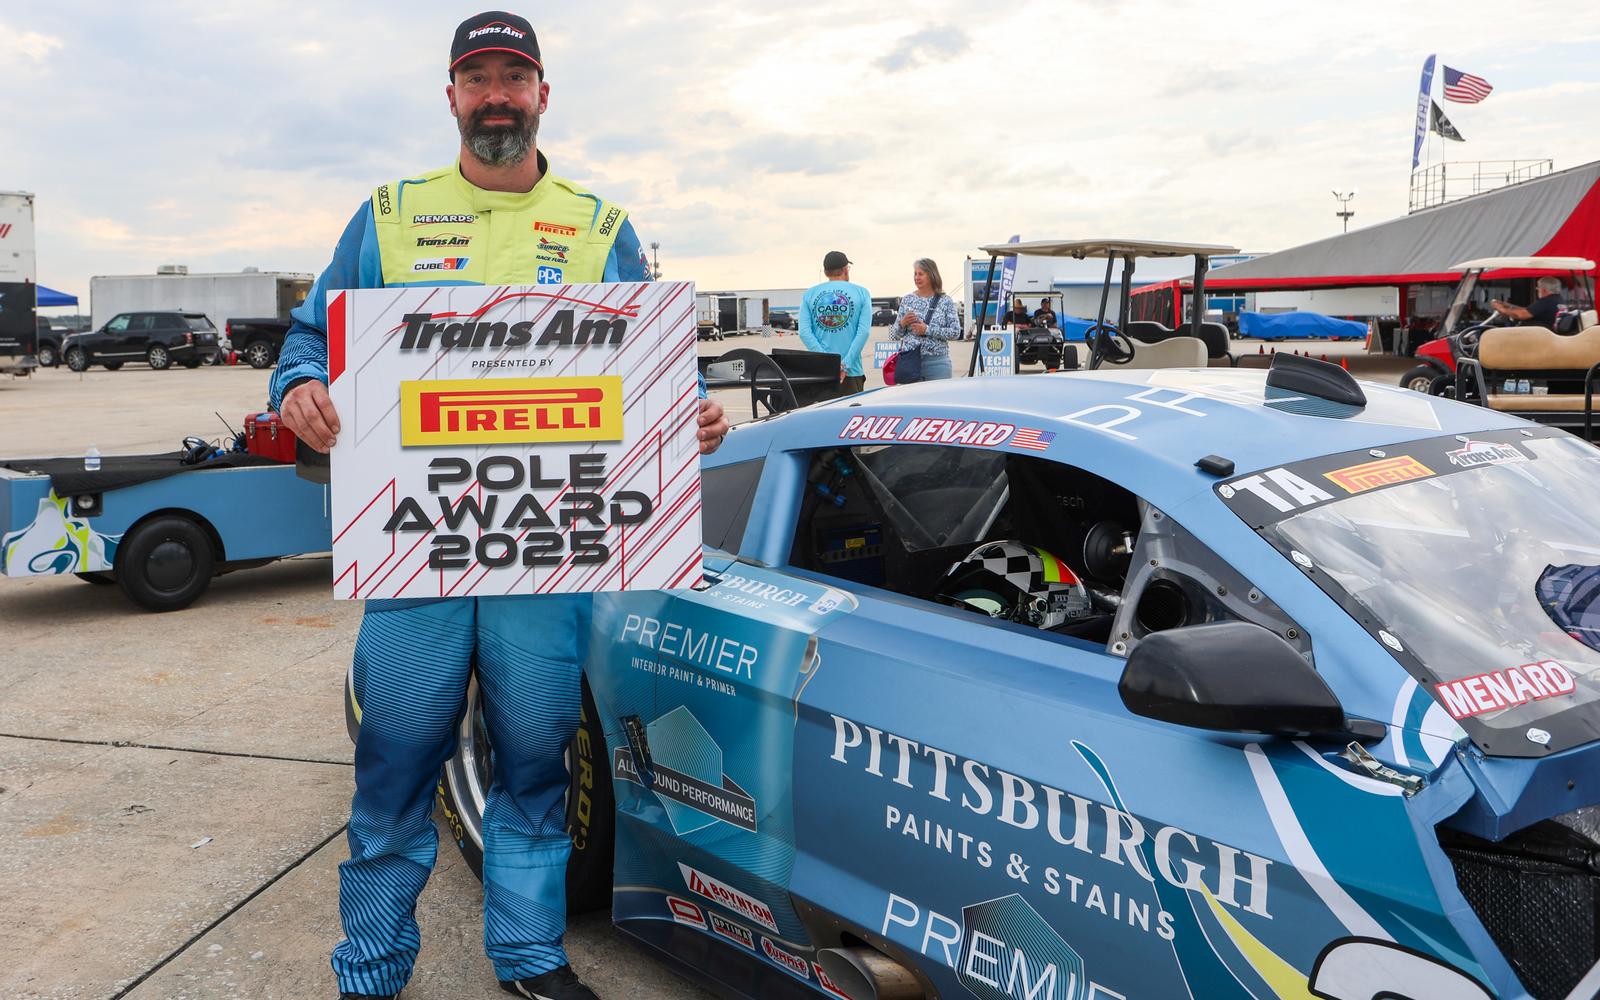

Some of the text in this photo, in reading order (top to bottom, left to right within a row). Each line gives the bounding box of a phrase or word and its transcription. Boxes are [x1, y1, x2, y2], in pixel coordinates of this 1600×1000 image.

[468, 26, 523, 40] Trans Am
[413, 215, 475, 223] MENARDS
[533, 221, 577, 236] PIRELLI
[417, 236, 470, 247] Trans Am
[538, 243, 570, 253] SUNOCO
[538, 268, 561, 283] PPG
[817, 305, 848, 313] CABO
[400, 309, 628, 349] Trans Am
[876, 343, 896, 351] THANK
[982, 355, 1010, 366] TECH
[471, 358, 554, 369] PRESENTED BY
[420, 387, 604, 433] PIRELLI
[839, 416, 1014, 446] PAUL MENARD
[1449, 446, 1522, 466] Trans Am
[427, 453, 608, 492] POLE
[1328, 457, 1429, 492] PIRELLI
[1230, 467, 1336, 513] TA
[382, 490, 653, 532] AWARD
[428, 529, 610, 569] 2025
[710, 590, 766, 609] & STAINS
[620, 614, 758, 680] PREMIER
[669, 667, 695, 684] PAINT
[697, 675, 703, 687] &
[705, 677, 736, 697] PRIMER
[1438, 661, 1575, 718] MENARD
[576, 708, 593, 828] ERO
[682, 785, 754, 824] PERFORMANCE
[829, 713, 1273, 920] PITTSBURGH
[885, 804, 1177, 942] PAINTS & STAINS
[709, 881, 774, 924] BOYNTON
[713, 917, 751, 941] OPTIMA
